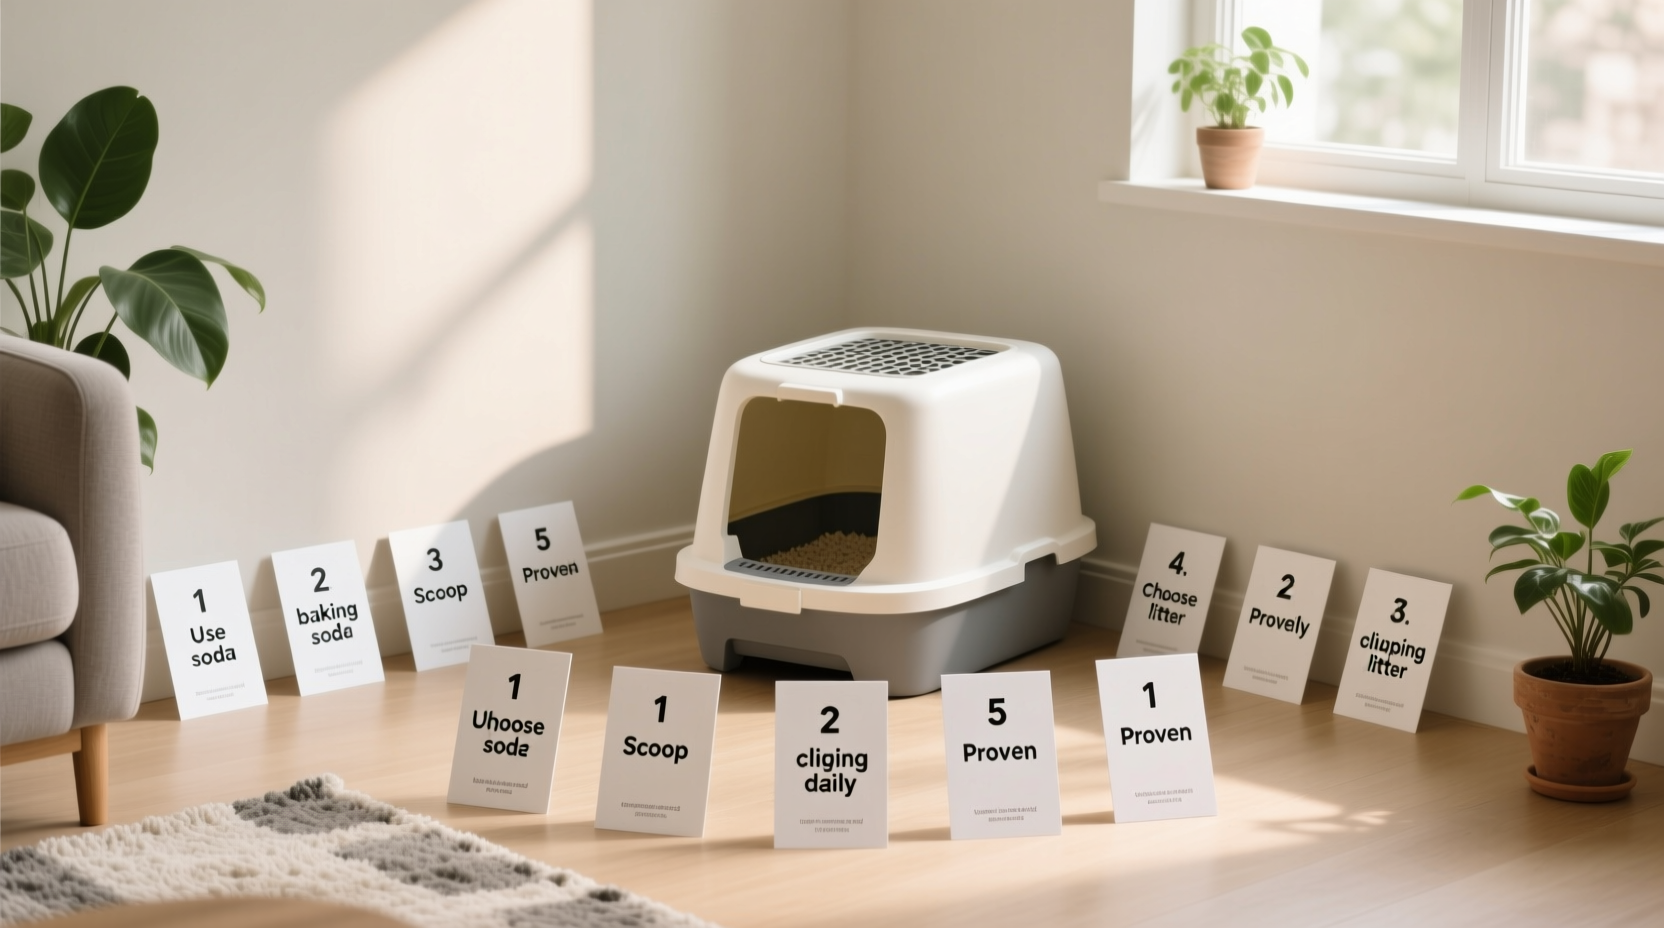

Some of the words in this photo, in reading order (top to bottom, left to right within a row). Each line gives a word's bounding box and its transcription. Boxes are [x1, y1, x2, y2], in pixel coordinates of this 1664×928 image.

[534, 527, 551, 551] 5
[427, 547, 443, 572] 3
[1168, 551, 1188, 577] 4.
[310, 567, 330, 593] 2
[522, 562, 579, 584] Proven
[413, 584, 468, 604] Scoop
[1142, 581, 1198, 608] Choose
[1276, 573, 1295, 601] 2
[193, 588, 207, 613] 1
[296, 602, 358, 625] baking
[1147, 602, 1187, 626] litter
[190, 626, 226, 644] Use
[311, 622, 353, 645] soda
[191, 644, 237, 667] soda
[508, 673, 522, 700] 1
[1142, 681, 1156, 709] 1
[654, 695, 668, 723] 1
[820, 705, 840, 734] 2
[988, 697, 1007, 726] 5
[472, 709, 545, 736] Uhoose
[1120, 726, 1192, 746] Proven
[622, 735, 689, 765] Scoop
[796, 747, 868, 773] cliging
[963, 743, 1037, 762] Proven
[804, 772, 857, 798] daily
